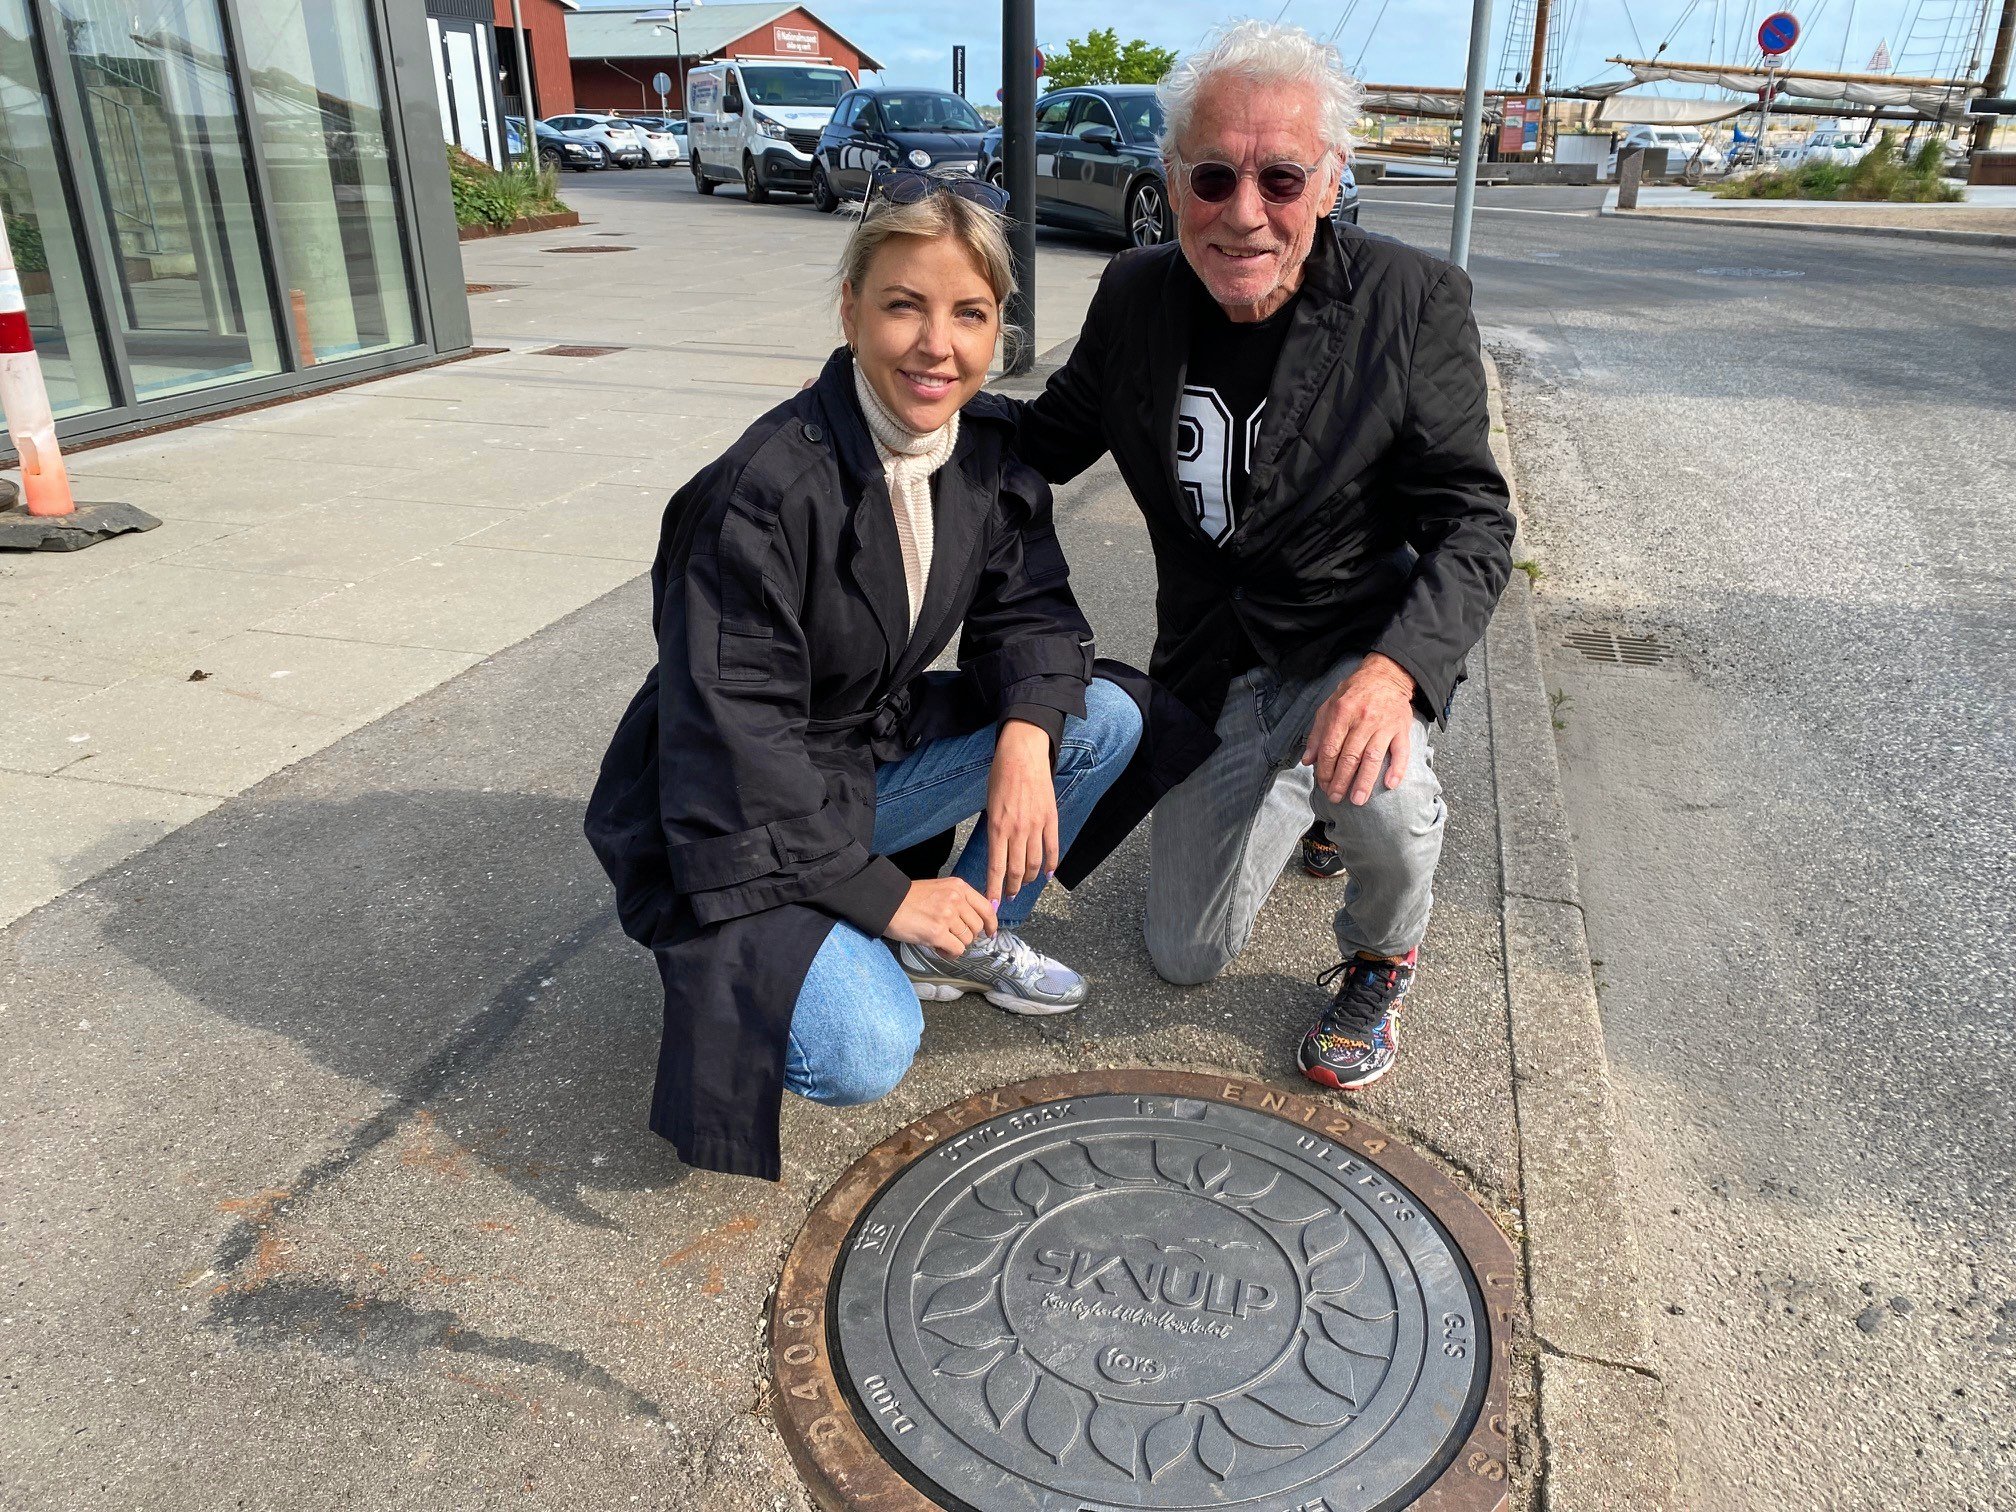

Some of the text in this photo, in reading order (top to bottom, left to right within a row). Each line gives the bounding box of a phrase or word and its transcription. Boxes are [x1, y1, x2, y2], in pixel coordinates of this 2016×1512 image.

[1296, 1135, 1416, 1222] ULEFOS
[781, 1307, 847, 1445] D400
[1105, 1346, 1158, 1374] fors
[863, 1374, 918, 1436] D400
